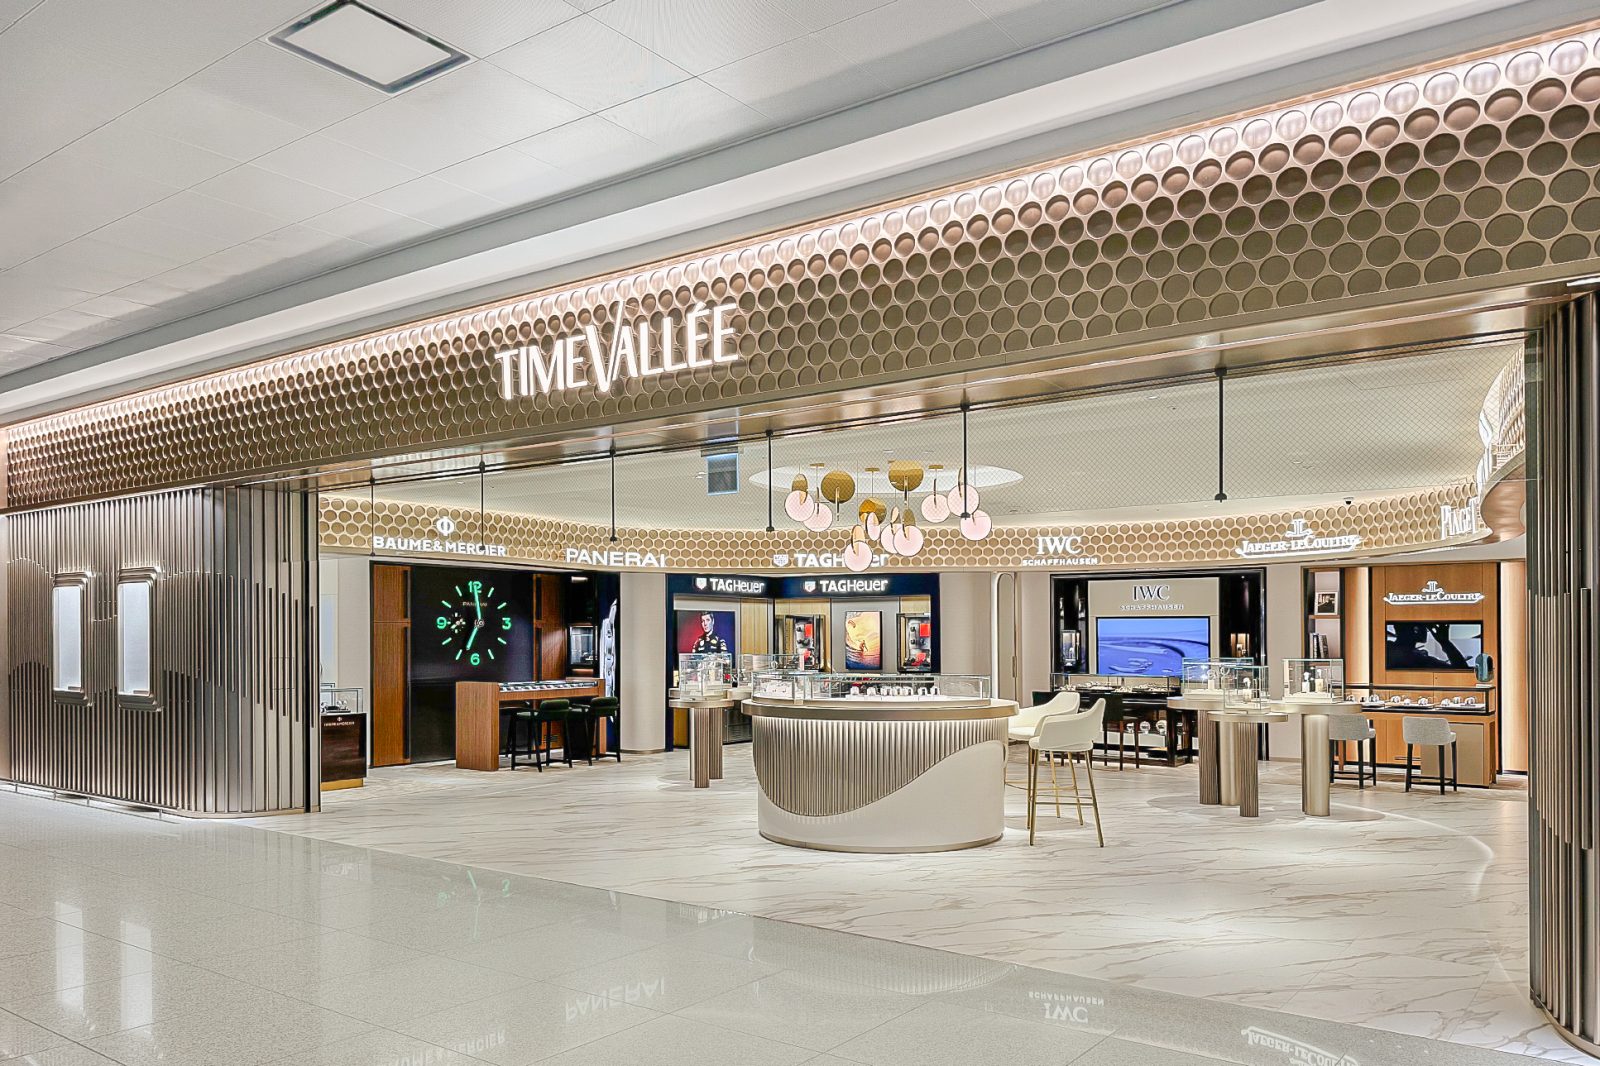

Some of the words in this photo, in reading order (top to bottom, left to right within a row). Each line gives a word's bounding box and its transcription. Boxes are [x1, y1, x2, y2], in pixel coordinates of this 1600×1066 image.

[1038, 536, 1082, 554] IWC
[565, 549, 665, 567] PANERAI
[468, 581, 482, 593] 12
[1132, 585, 1170, 600] IWC
[436, 617, 447, 629] 9
[502, 618, 512, 629] 3
[470, 653, 480, 665] 6
